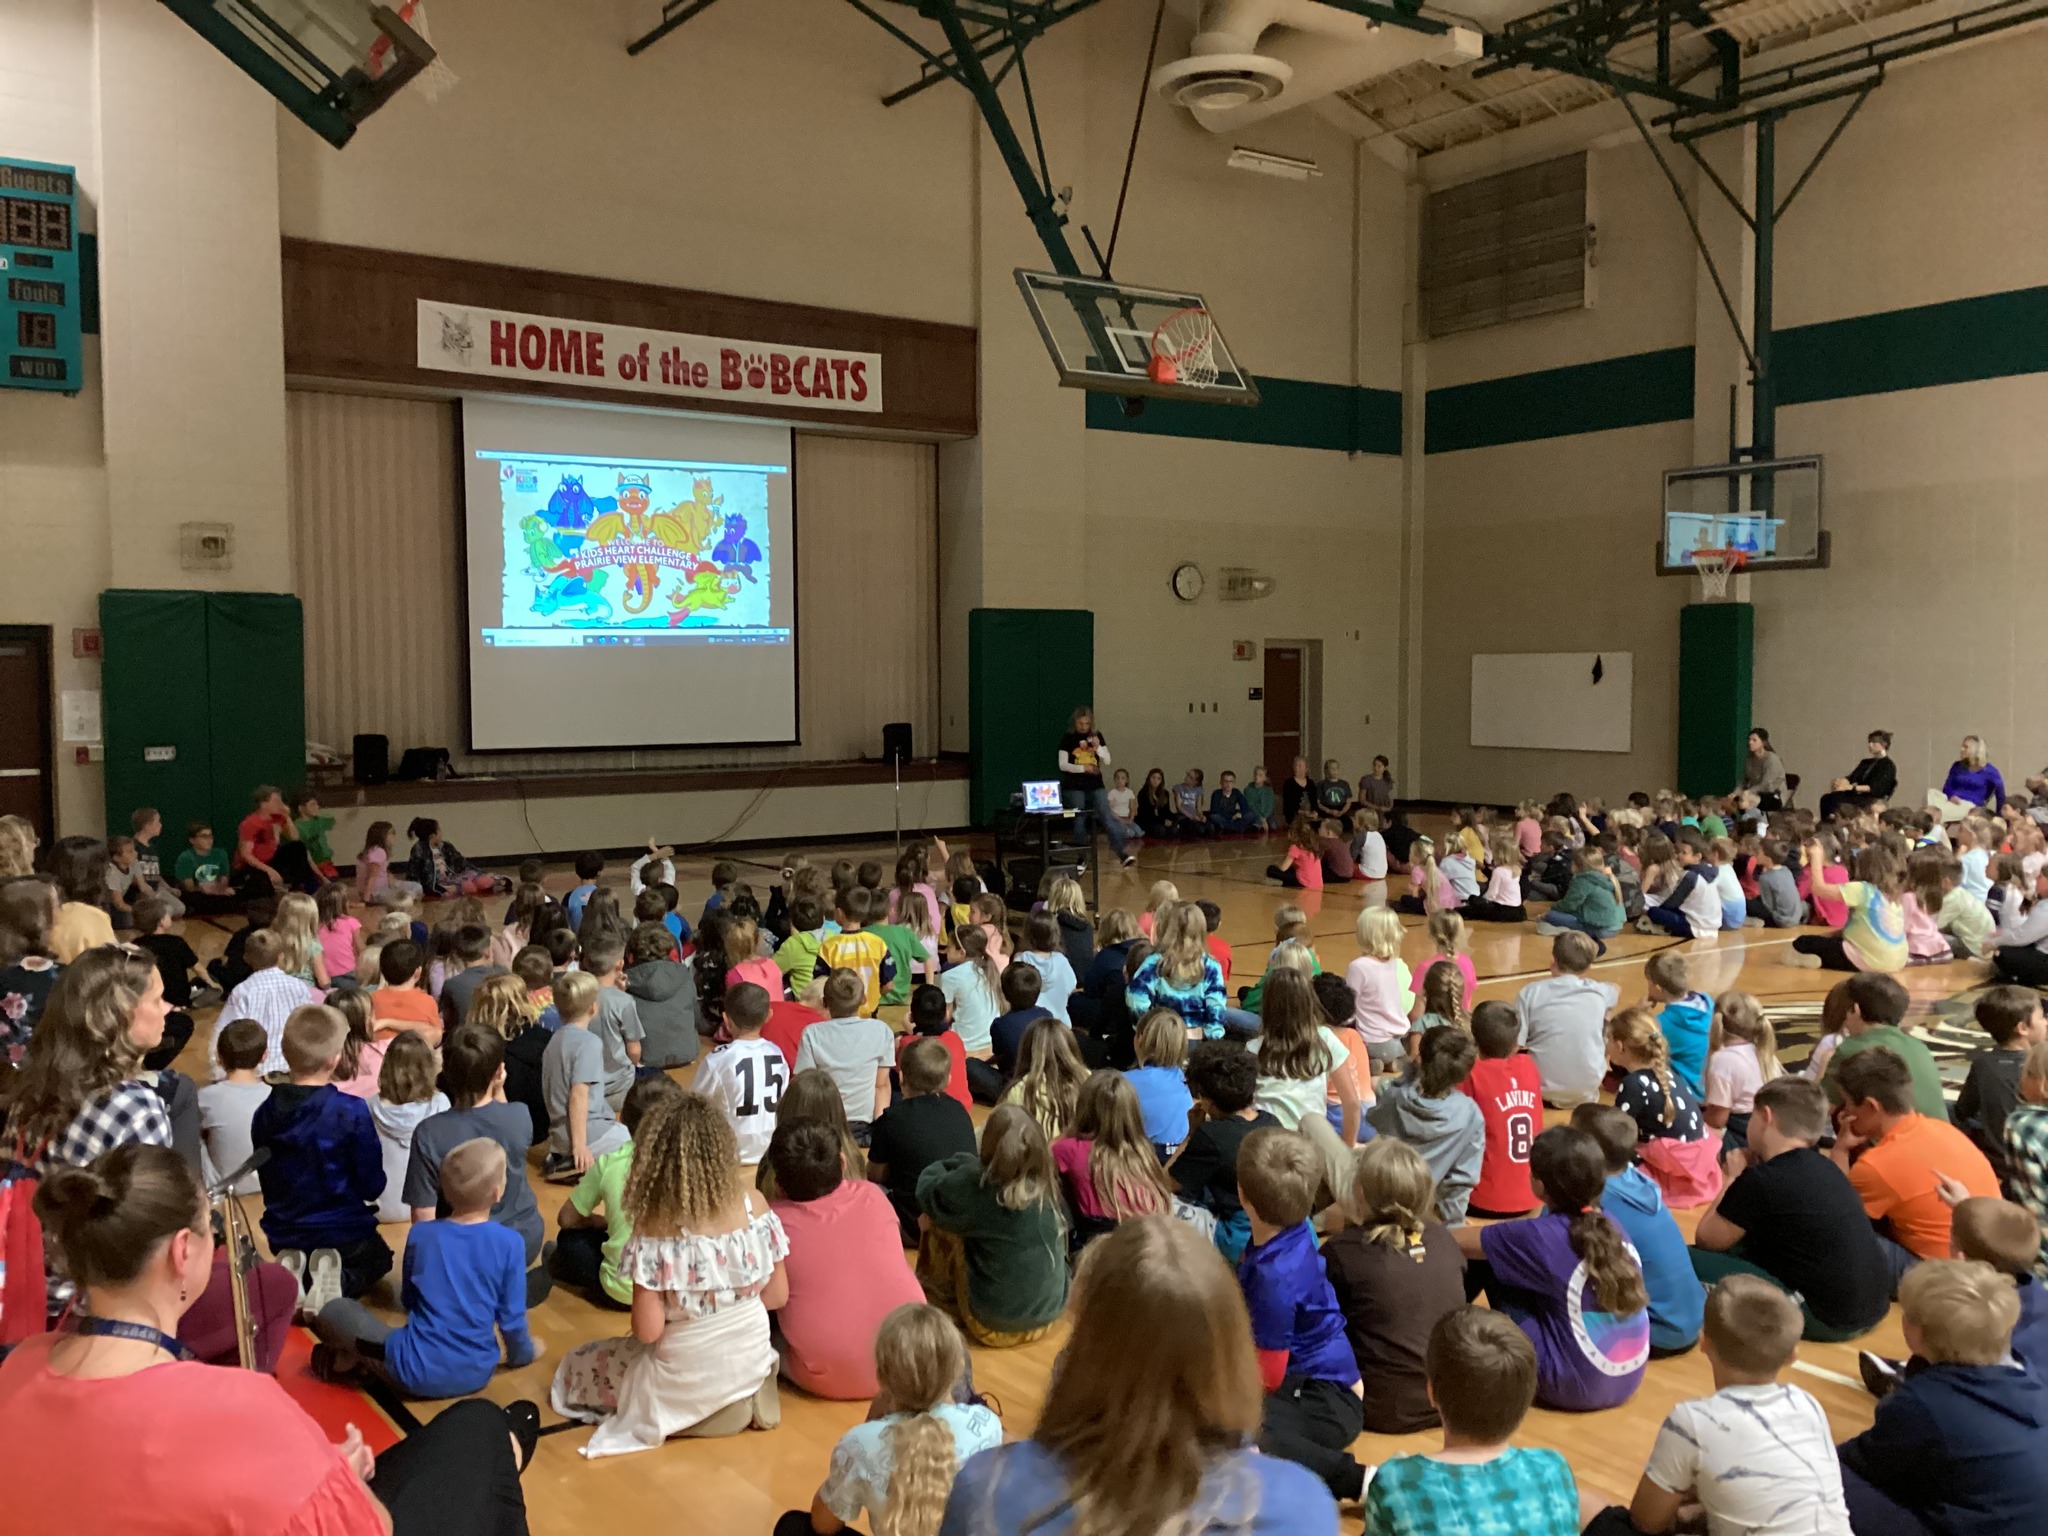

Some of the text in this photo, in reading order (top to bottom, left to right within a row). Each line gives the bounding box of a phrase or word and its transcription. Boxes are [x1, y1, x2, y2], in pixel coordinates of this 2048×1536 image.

[490, 319, 605, 377] HOME
[618, 342, 650, 382] of
[659, 346, 709, 388] the
[580, 546, 691, 560] KIDS HEART CHALLENGE
[607, 538, 650, 546] WELCME
[575, 555, 698, 571] PRAIRIE VIEW ELEMENTARY
[735, 1054, 783, 1117] 15
[1495, 1089, 1536, 1112] LAVINE
[1507, 1113, 1534, 1163] 8
